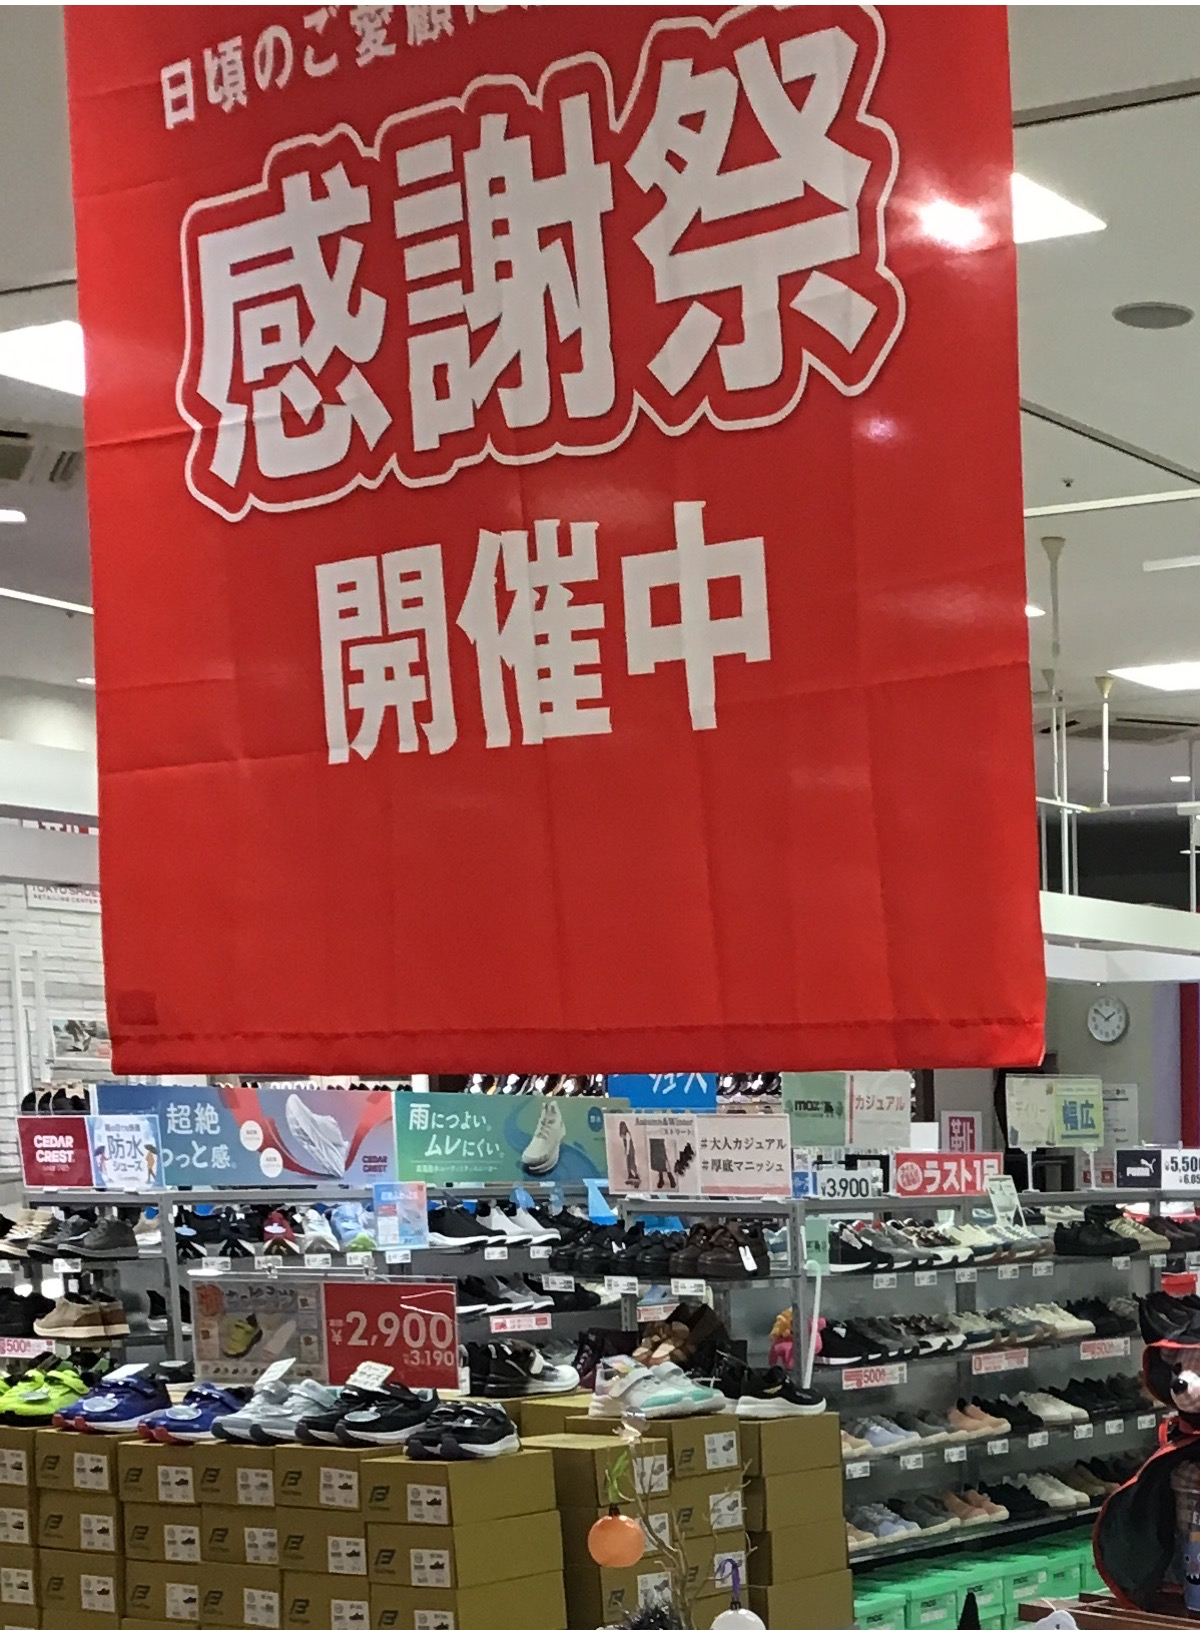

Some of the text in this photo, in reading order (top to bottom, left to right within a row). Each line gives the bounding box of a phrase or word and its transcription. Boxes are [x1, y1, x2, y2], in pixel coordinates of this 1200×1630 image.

[161, 5, 505, 130] 日頃のご愛顧
[197, 25, 878, 487] 感謝祭
[315, 500, 772, 765] 開催中
[408, 1102, 493, 1132] 雨につよい。
[855, 1095, 905, 1113] カジュアル
[1062, 1099, 1097, 1131] 幅広
[166, 1102, 221, 1135] 超絶
[33, 1135, 74, 1149] CEDAR
[107, 1135, 145, 1161] 防水
[424, 1133, 505, 1158] ムレにくい。
[700, 1136, 787, 1151] #大人カジュアル
[35, 1150, 76, 1164] CREST
